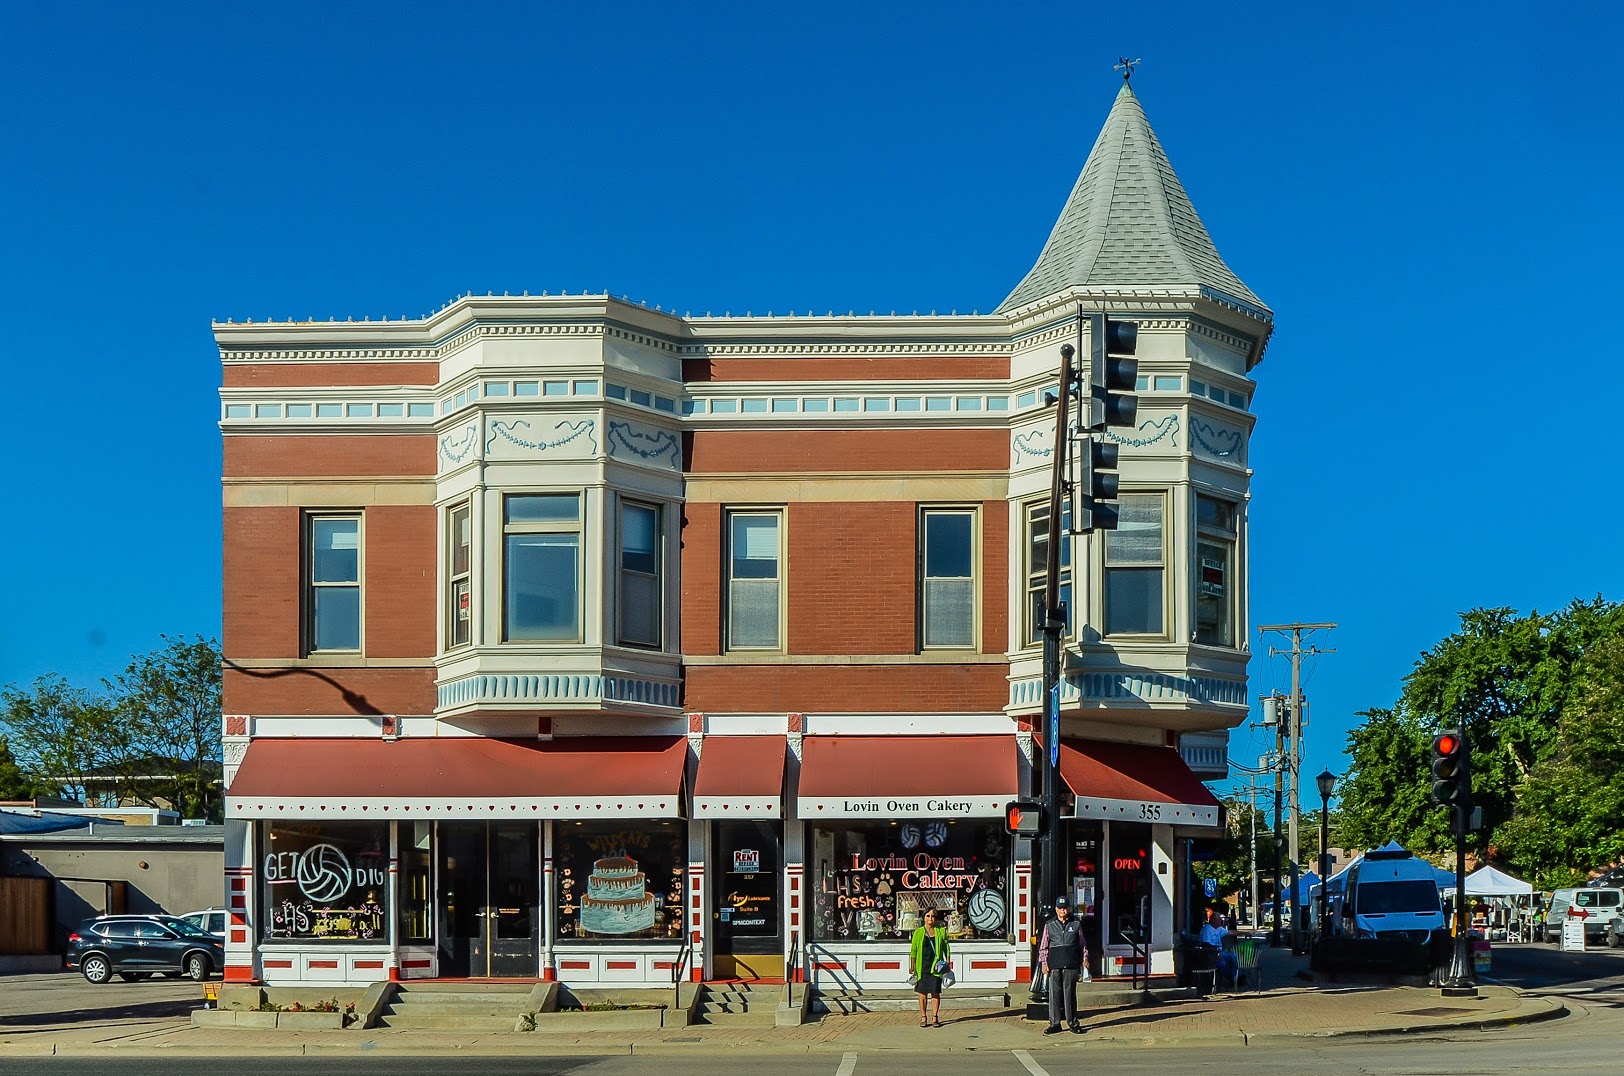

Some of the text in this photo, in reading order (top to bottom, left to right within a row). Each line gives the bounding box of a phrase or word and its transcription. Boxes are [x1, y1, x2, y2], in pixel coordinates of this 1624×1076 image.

[843, 799, 973, 814] Lovin Oven Cakery
[1138, 803, 1162, 821] 355
[263, 851, 299, 881] GET
[735, 852, 758, 862] RENT
[850, 852, 965, 872] Lovin Oven
[1114, 858, 1141, 870] OPEN
[356, 868, 384, 887] DIG
[822, 874, 863, 896] LHS
[901, 870, 979, 893] Cakery
[837, 894, 875, 909] fresh
[269, 904, 309, 933] LHS
